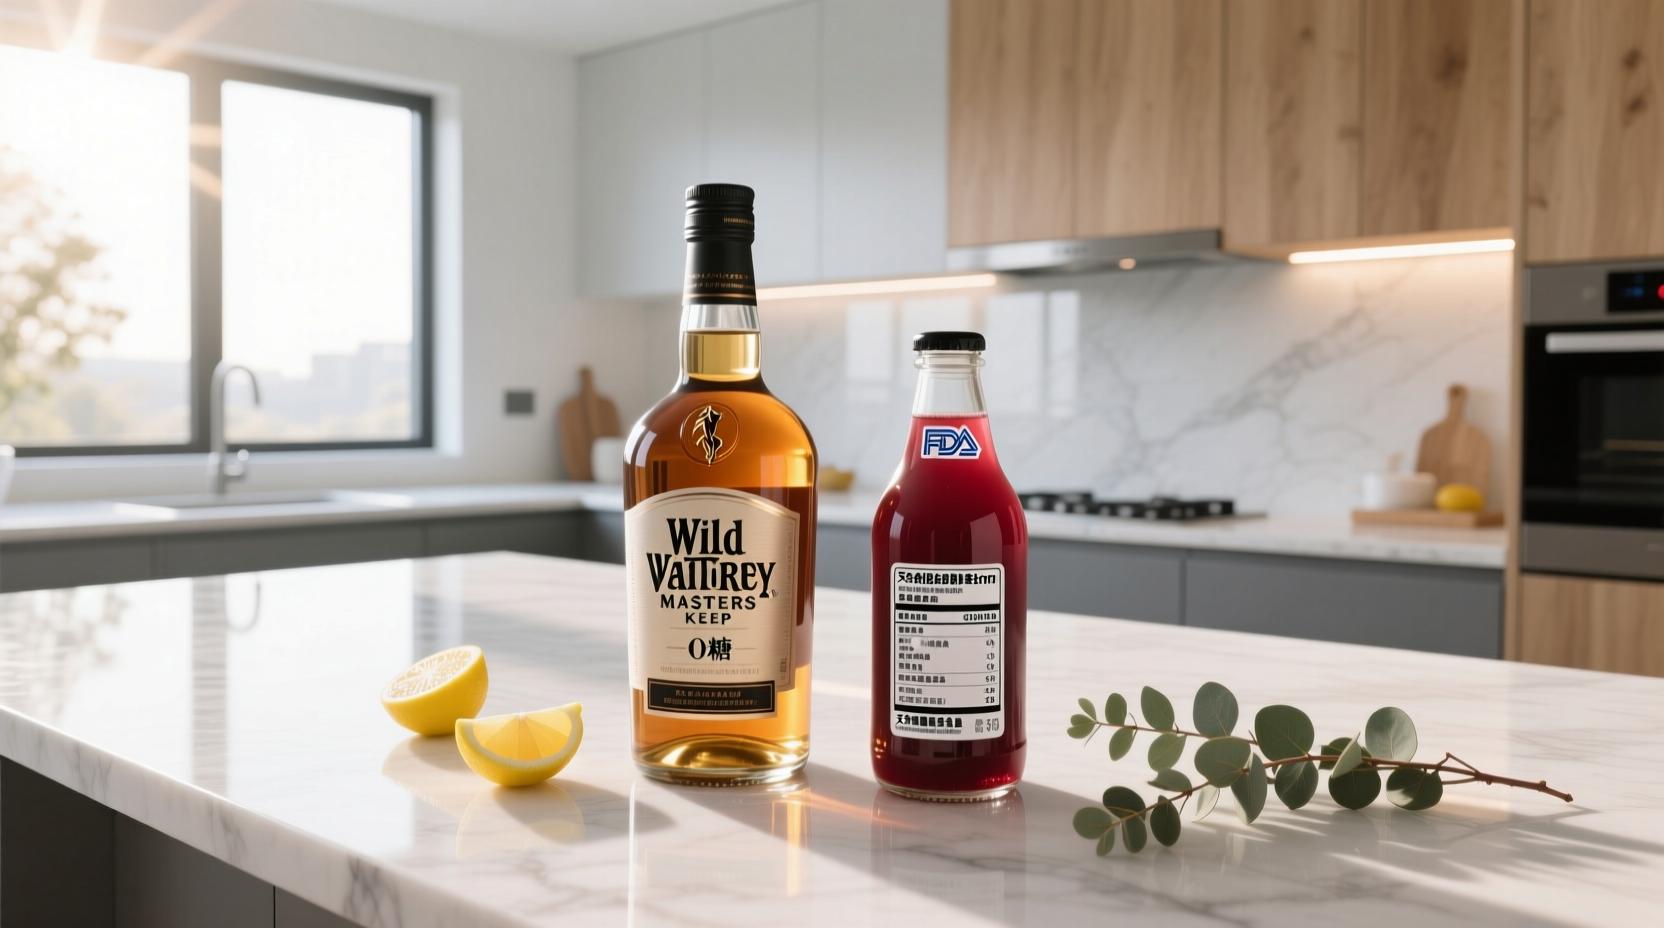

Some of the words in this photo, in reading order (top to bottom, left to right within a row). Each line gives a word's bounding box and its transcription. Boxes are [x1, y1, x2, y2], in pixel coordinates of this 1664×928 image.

[923, 428, 979, 456] FDA
[666, 518, 746, 555] Wild
[660, 594, 756, 610] MASTERS
[685, 612, 732, 625] KEEP
